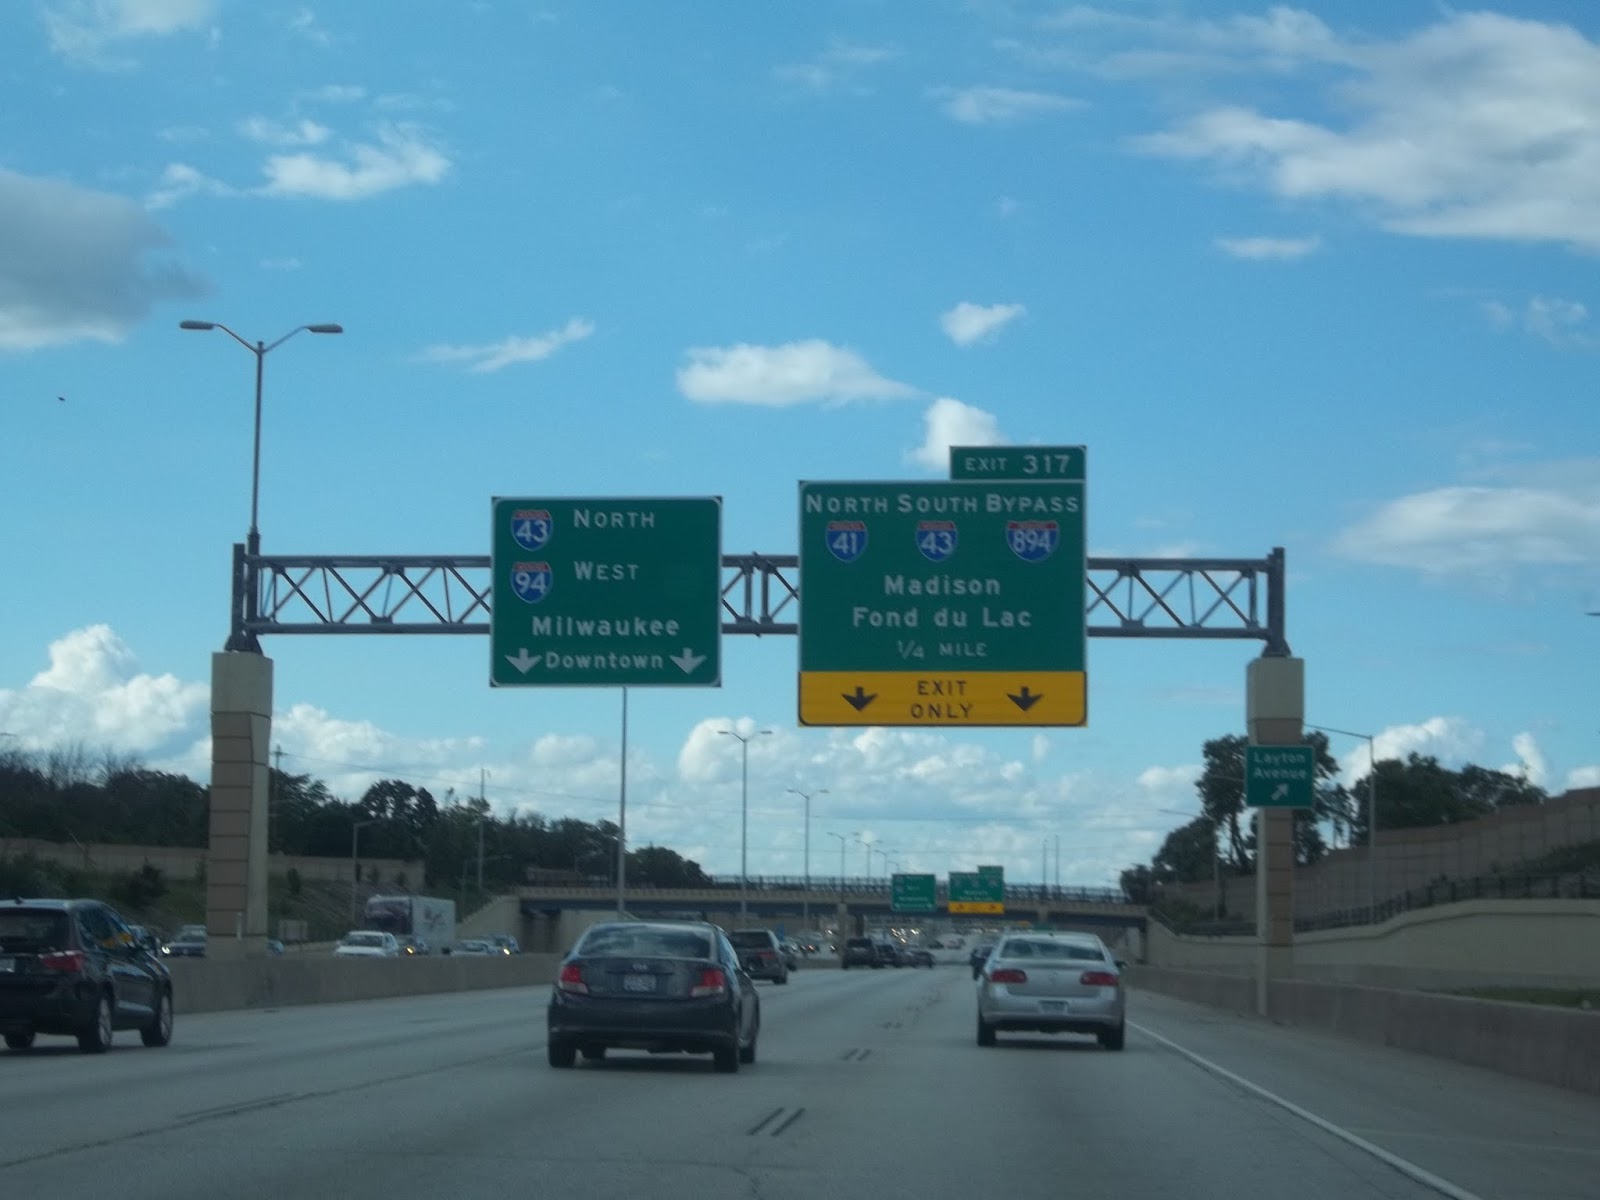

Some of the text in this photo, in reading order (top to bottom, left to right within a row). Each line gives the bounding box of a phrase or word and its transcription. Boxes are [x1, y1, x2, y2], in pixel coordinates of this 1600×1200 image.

[965, 454, 1071, 474] EXIT 317
[805, 493, 1080, 513] NORTH SOUTH BYPASS
[573, 509, 655, 528] NORTH
[516, 520, 548, 543] 43
[832, 531, 858, 553] 41
[921, 531, 952, 554] 43
[1012, 530, 1051, 554] 894
[573, 561, 640, 580] WEST
[514, 572, 547, 595] 94
[884, 574, 1001, 595] Madison
[531, 615, 680, 636] Milwaukee
[852, 607, 1032, 627] Fond du Lac
[938, 642, 988, 657] MILE
[545, 651, 664, 669] Downtown
[917, 681, 968, 696] EXIT
[910, 703, 973, 719] ONLY
